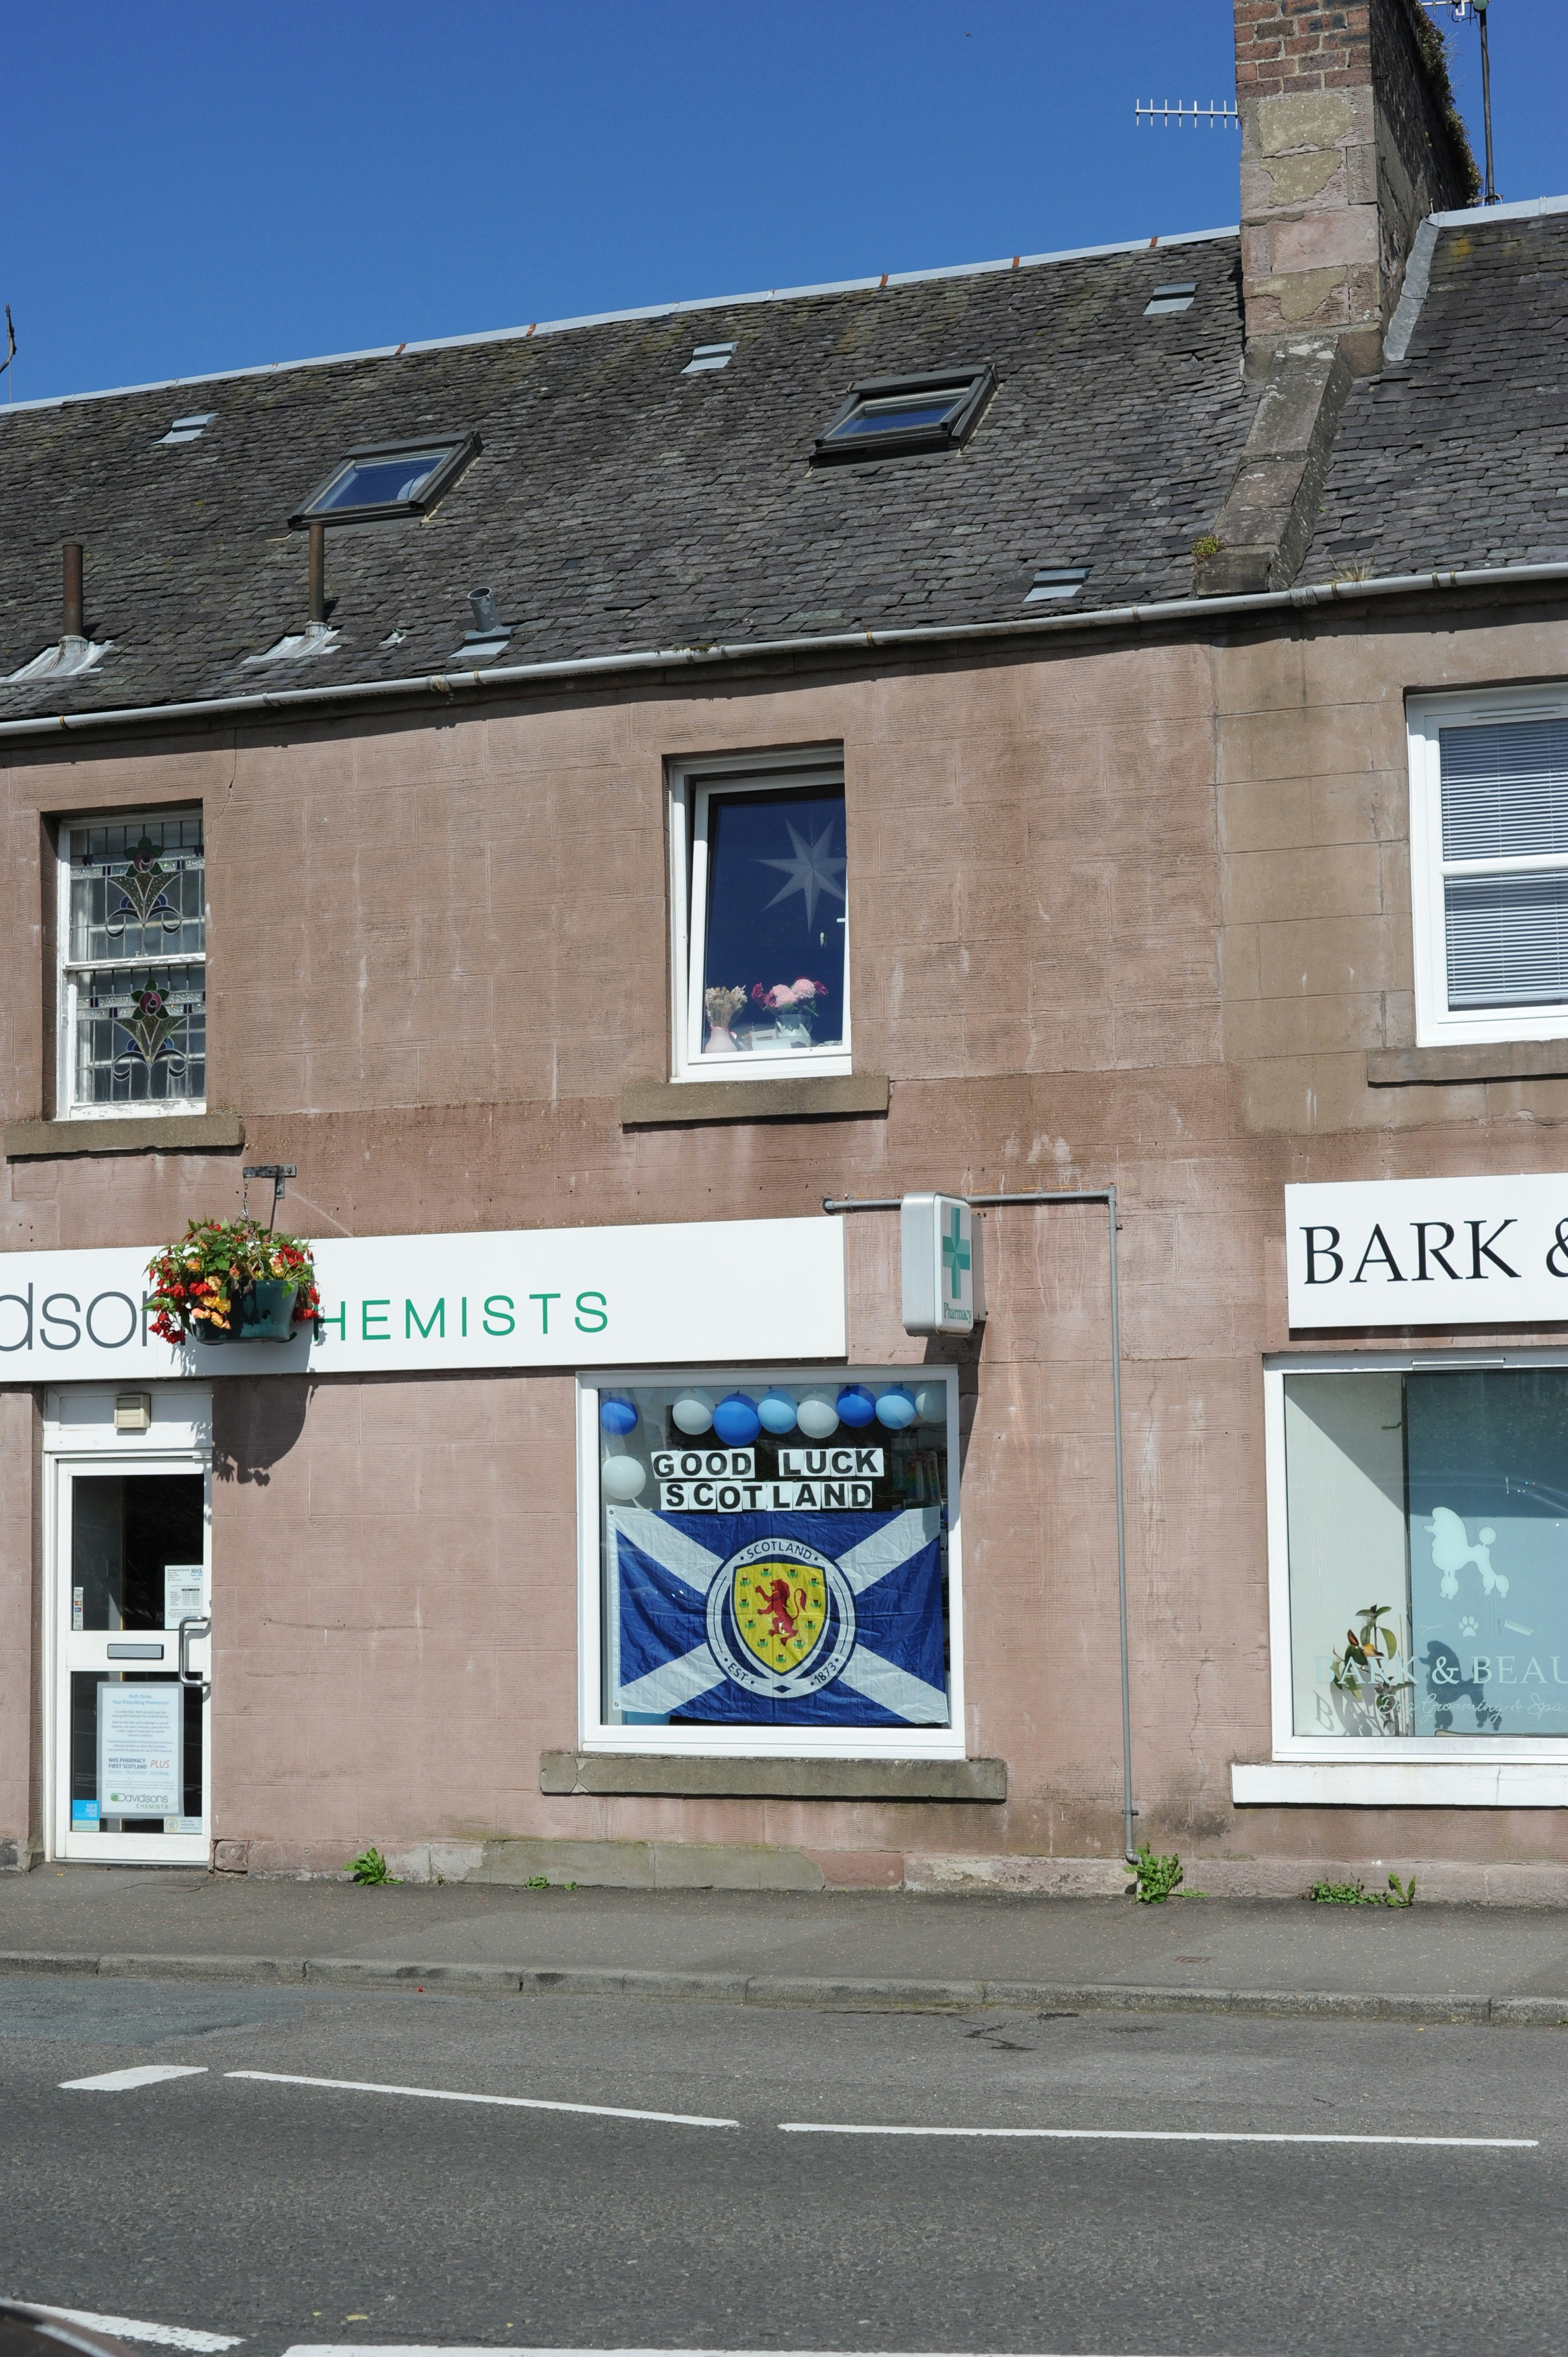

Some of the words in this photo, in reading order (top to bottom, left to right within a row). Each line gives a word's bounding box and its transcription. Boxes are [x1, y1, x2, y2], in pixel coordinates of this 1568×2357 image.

[1299, 1219, 1522, 1285] BARK
[275, 1291, 608, 1346] HEMISTS
[943, 1302, 972, 1325] Pharmacy
[653, 1452, 752, 1478] GOOD
[782, 1449, 879, 1476] LUCK
[666, 1483, 871, 1509] SCOTLAND
[746, 1541, 812, 1560] SCOTLAND
[727, 1661, 749, 1682] EST
[813, 1661, 837, 1684] 1873
[1314, 1656, 1420, 1684] BARK
[1432, 1656, 1459, 1684] &
[1379, 1694, 1421, 1723] Dog
[1422, 1693, 1508, 1725] Grooming
[1511, 1699, 1521, 1713] &
[1527, 1692, 1566, 1720] Spa
[150, 1760, 170, 1768] PLUS
[118, 1793, 168, 1803] Davidsons
